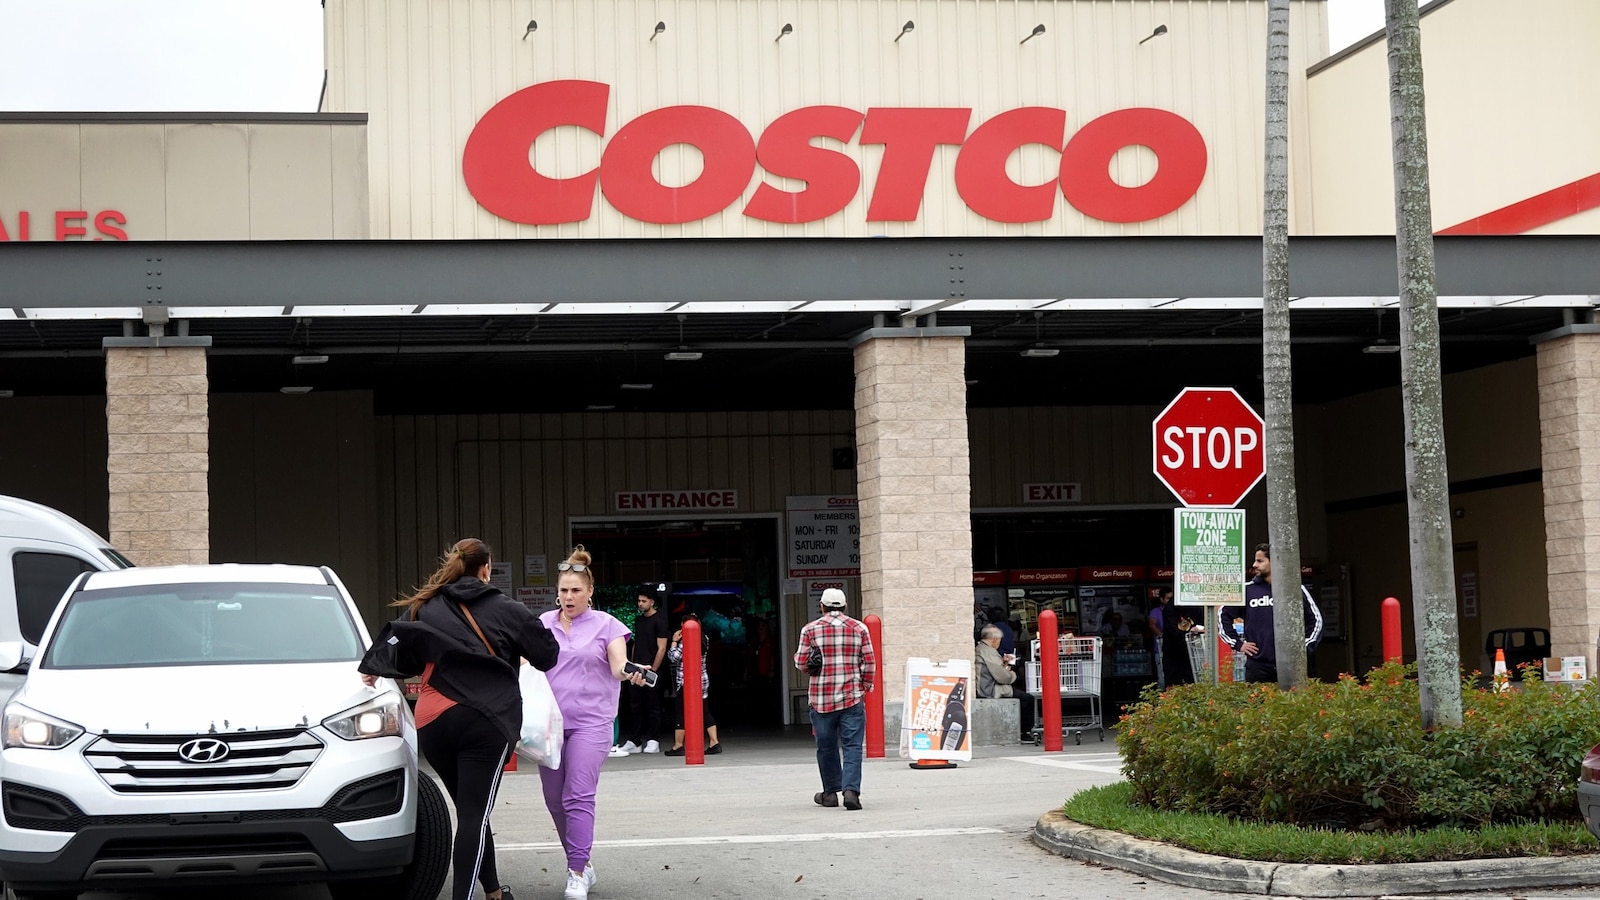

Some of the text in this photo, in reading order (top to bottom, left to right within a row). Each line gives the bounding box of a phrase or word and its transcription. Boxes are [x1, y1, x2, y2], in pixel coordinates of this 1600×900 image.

[462, 79, 1208, 225] COSTCO
[0, 210, 128, 242] LES
[1161, 426, 1258, 470] STOP
[618, 491, 735, 509] ENTRANCE
[1029, 485, 1076, 500] EXIT
[827, 497, 858, 505] COSTC
[814, 512, 856, 521] MEMBERS
[1182, 512, 1242, 530] TOW-AWAY
[795, 525, 815, 536] MON
[825, 525, 838, 535] FRI
[1196, 529, 1227, 546] ZONE
[795, 540, 836, 551] SATURDAY
[796, 554, 828, 565] SUNDAY
[1035, 572, 1067, 581] Organization
[1113, 569, 1133, 577] Flooring
[811, 581, 844, 589] COSTCO
[920, 688, 948, 704] GET
[918, 698, 946, 713] CAR
[915, 706, 944, 722] KEYS
